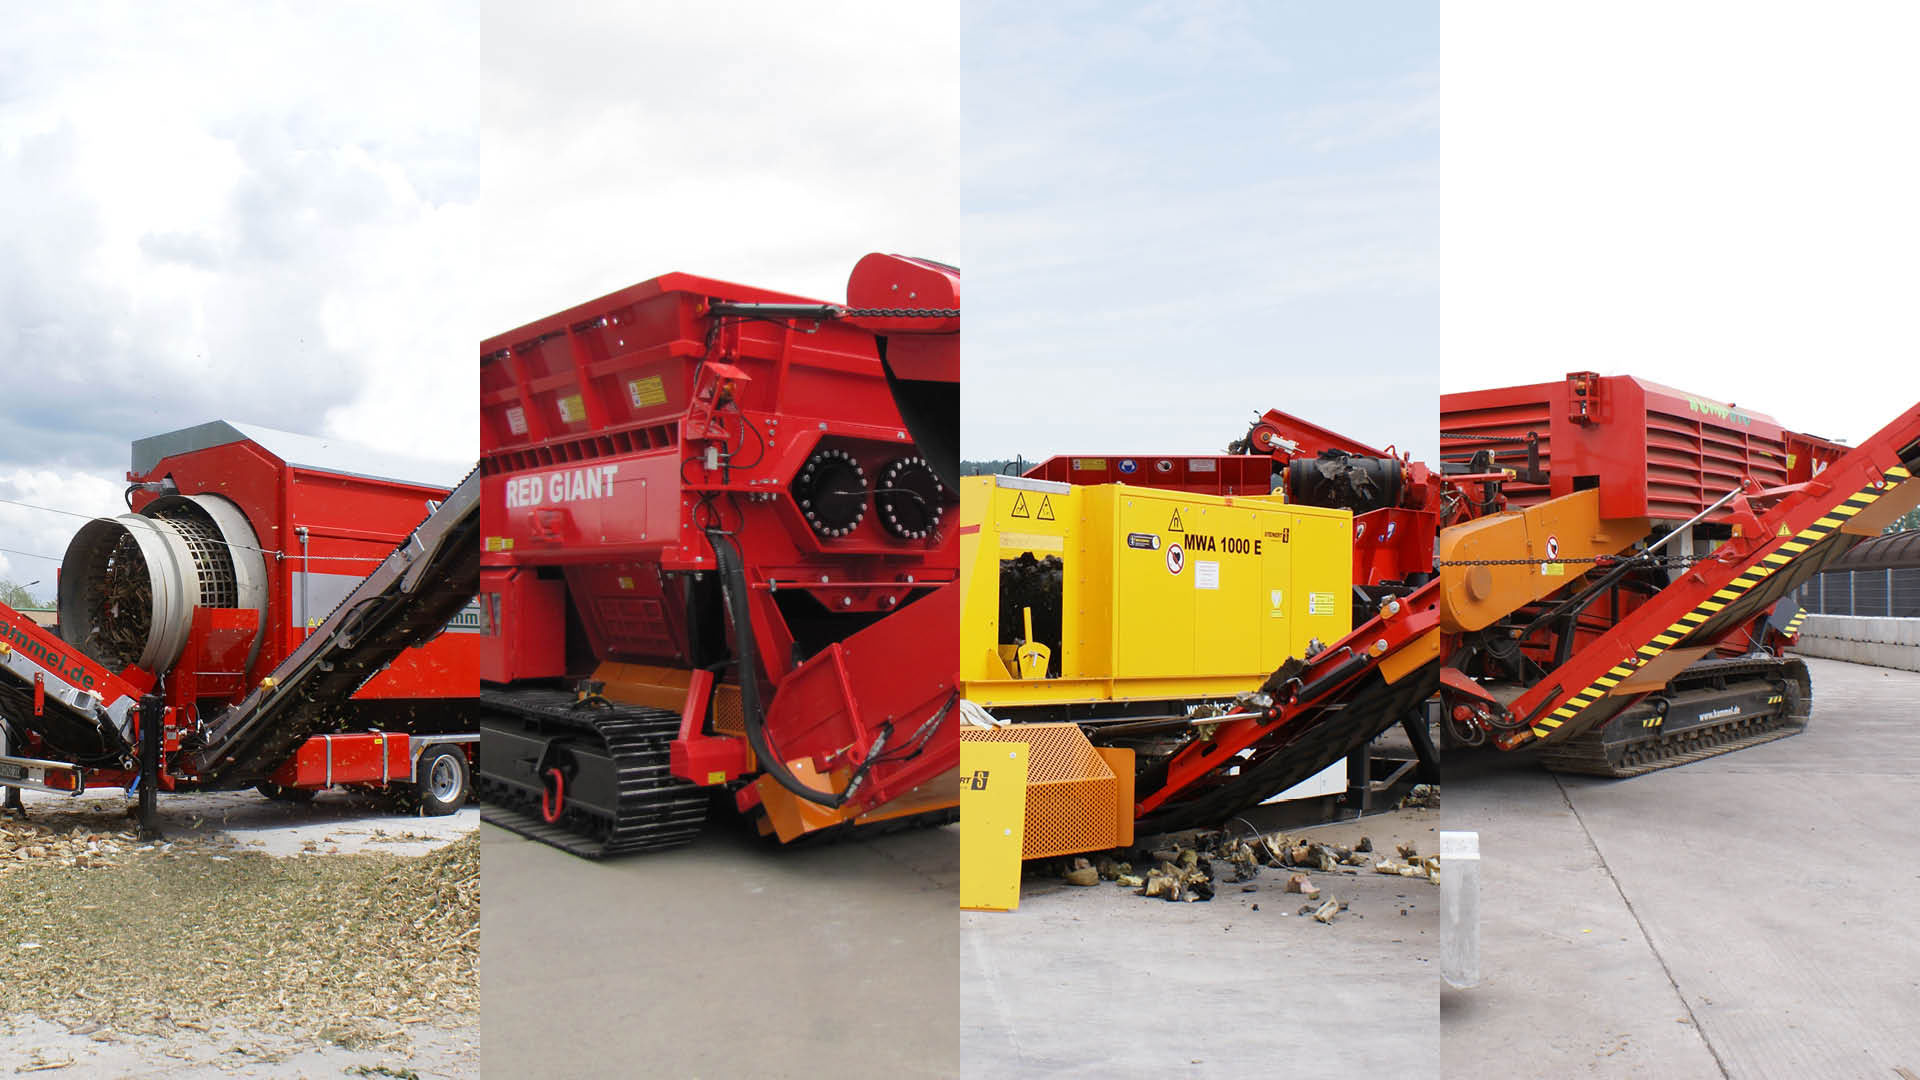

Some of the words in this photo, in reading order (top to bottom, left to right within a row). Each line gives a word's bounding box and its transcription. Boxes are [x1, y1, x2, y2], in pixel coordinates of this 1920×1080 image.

[506, 477, 543, 508] RED
[550, 465, 618, 503] GIANT
[1184, 534, 1216, 552] MWA
[1221, 537, 1250, 555] 1000
[1254, 540, 1262, 555] E
